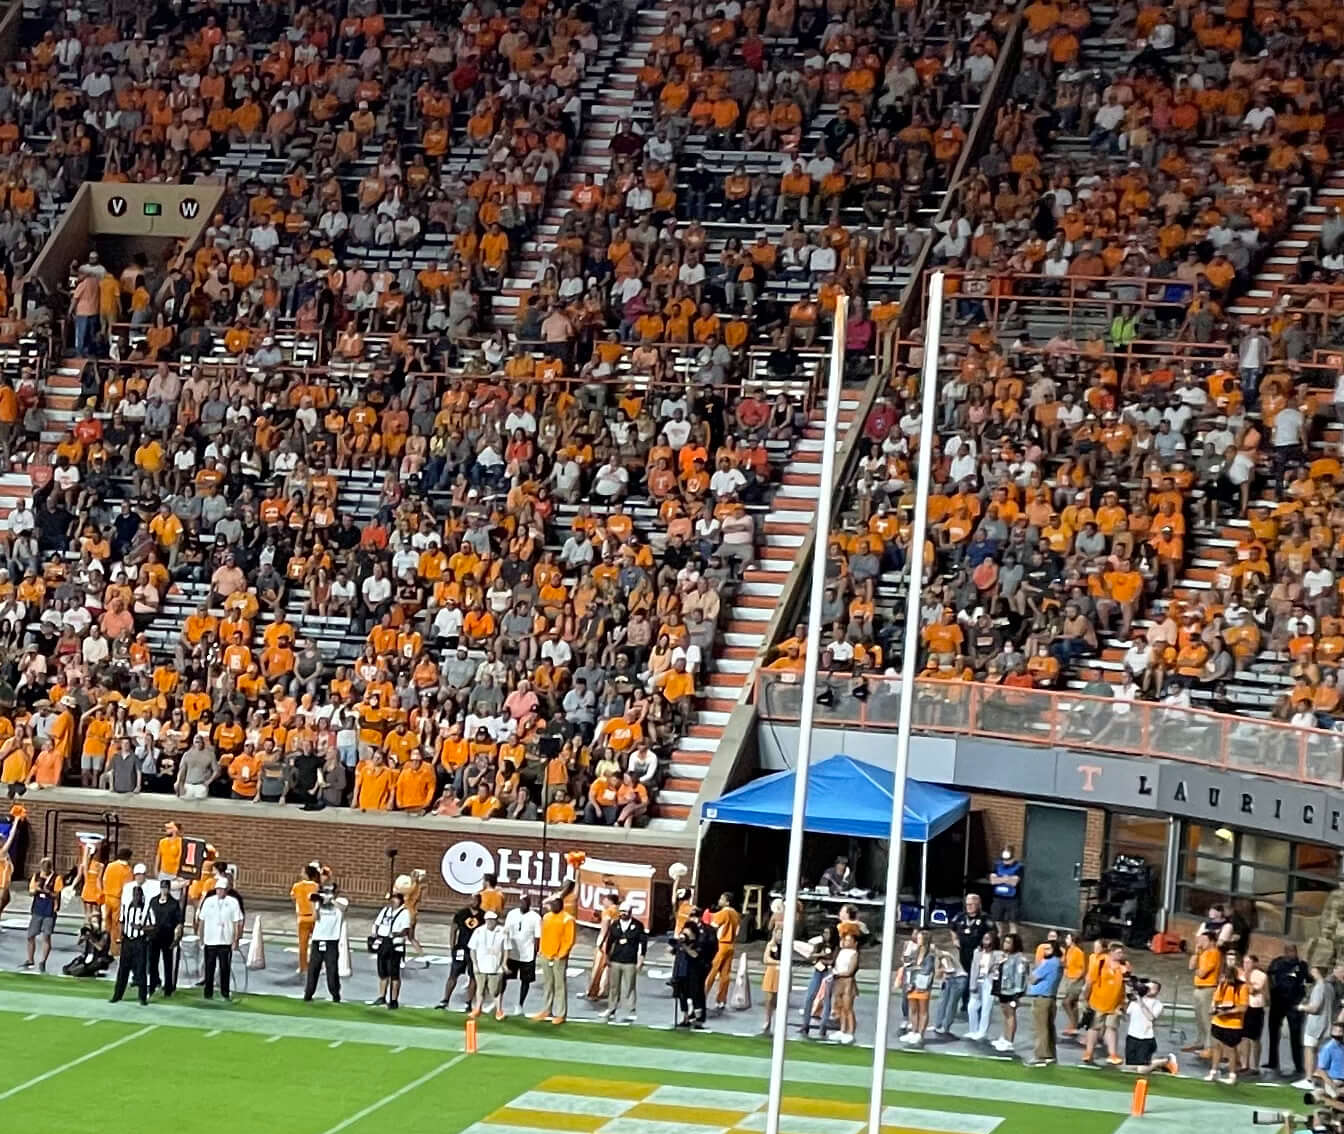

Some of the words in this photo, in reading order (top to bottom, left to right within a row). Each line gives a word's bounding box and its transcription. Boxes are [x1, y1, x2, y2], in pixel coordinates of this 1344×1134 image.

[112, 199, 123, 214] V
[181, 202, 198, 218] W
[1077, 765, 1102, 791] T
[1139, 775, 1340, 830] LAURICE
[580, 884, 648, 916] VOS
